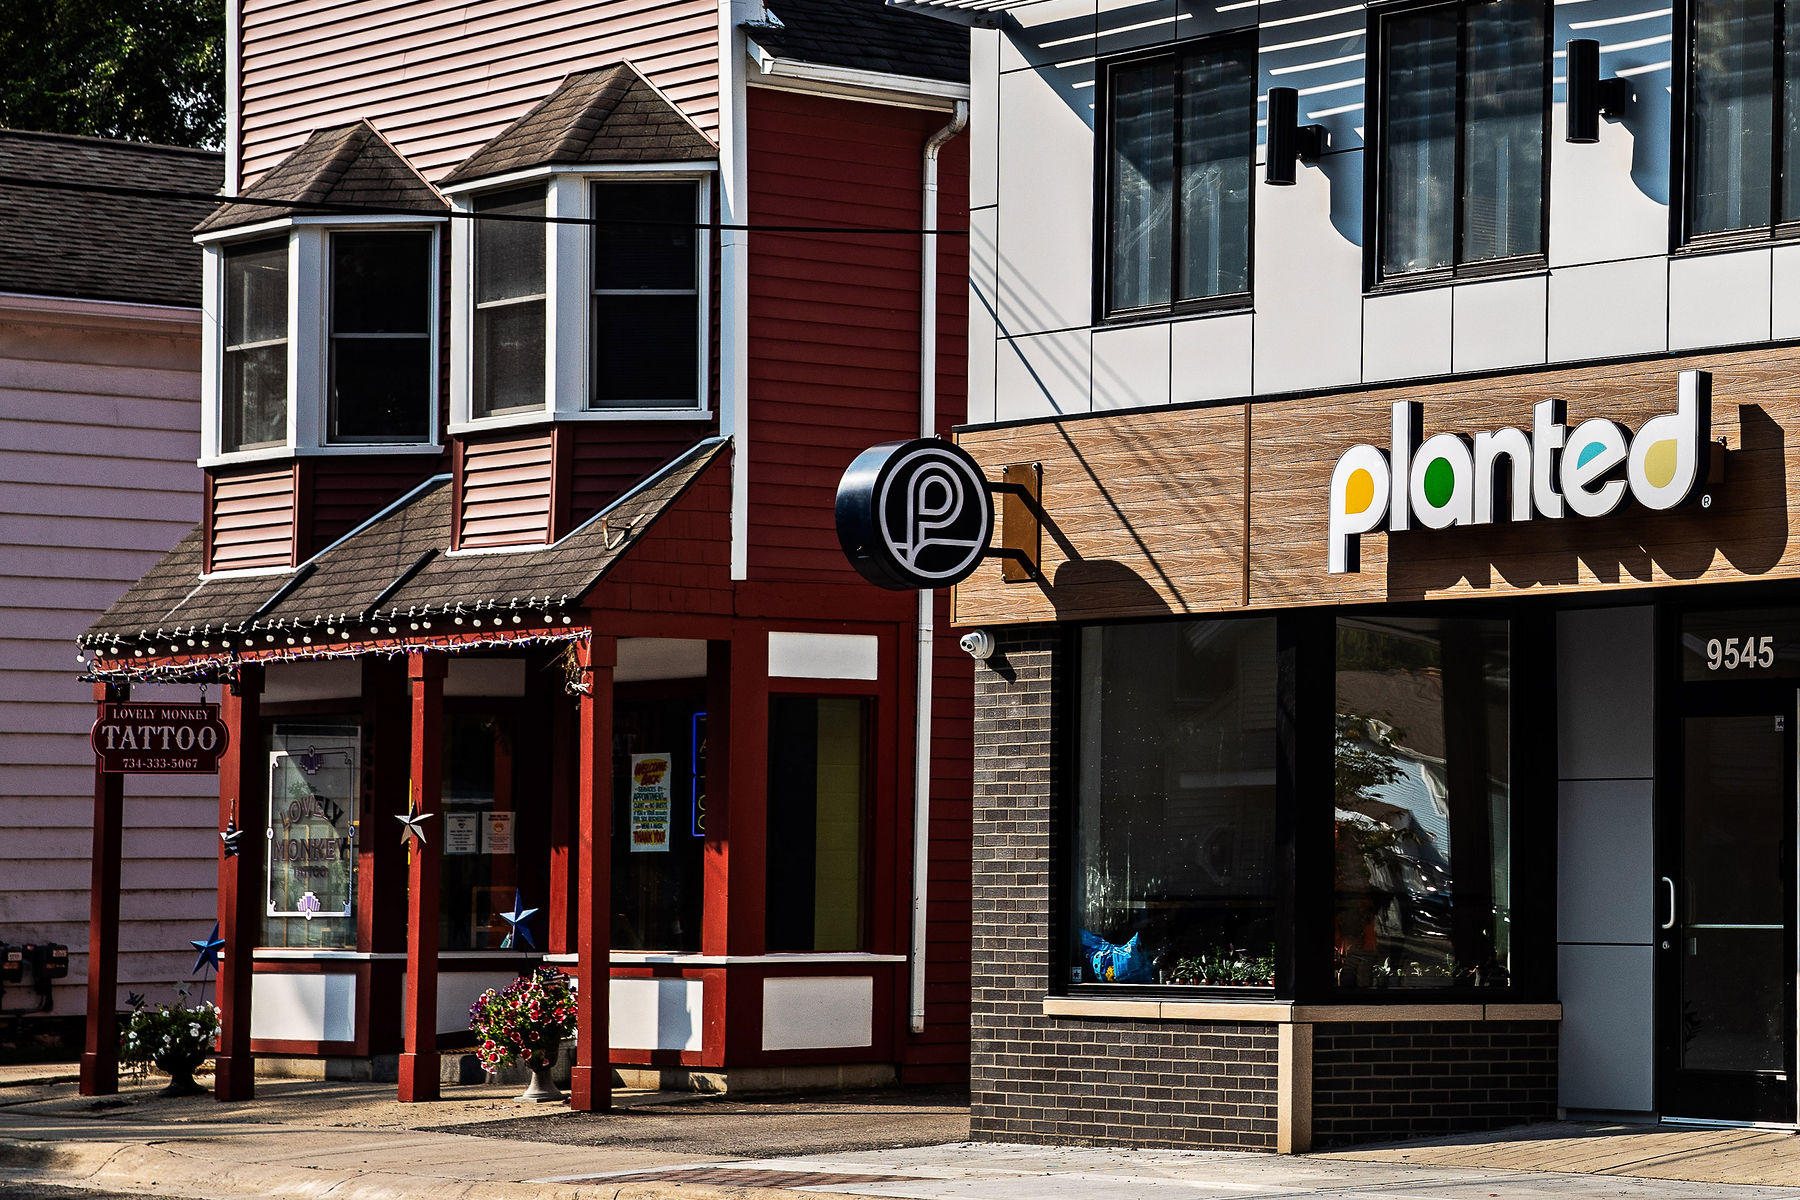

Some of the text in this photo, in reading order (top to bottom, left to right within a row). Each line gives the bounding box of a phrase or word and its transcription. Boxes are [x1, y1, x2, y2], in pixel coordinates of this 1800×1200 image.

[1328, 369, 1712, 574] planted
[1706, 636, 1775, 671] 9545
[113, 708, 210, 720] LOVELY MONKEY
[101, 725, 218, 751] TATTOO
[122, 758, 199, 769] 734-333-5067
[280, 795, 344, 831] LOVELY
[272, 837, 349, 861] MONKEY
